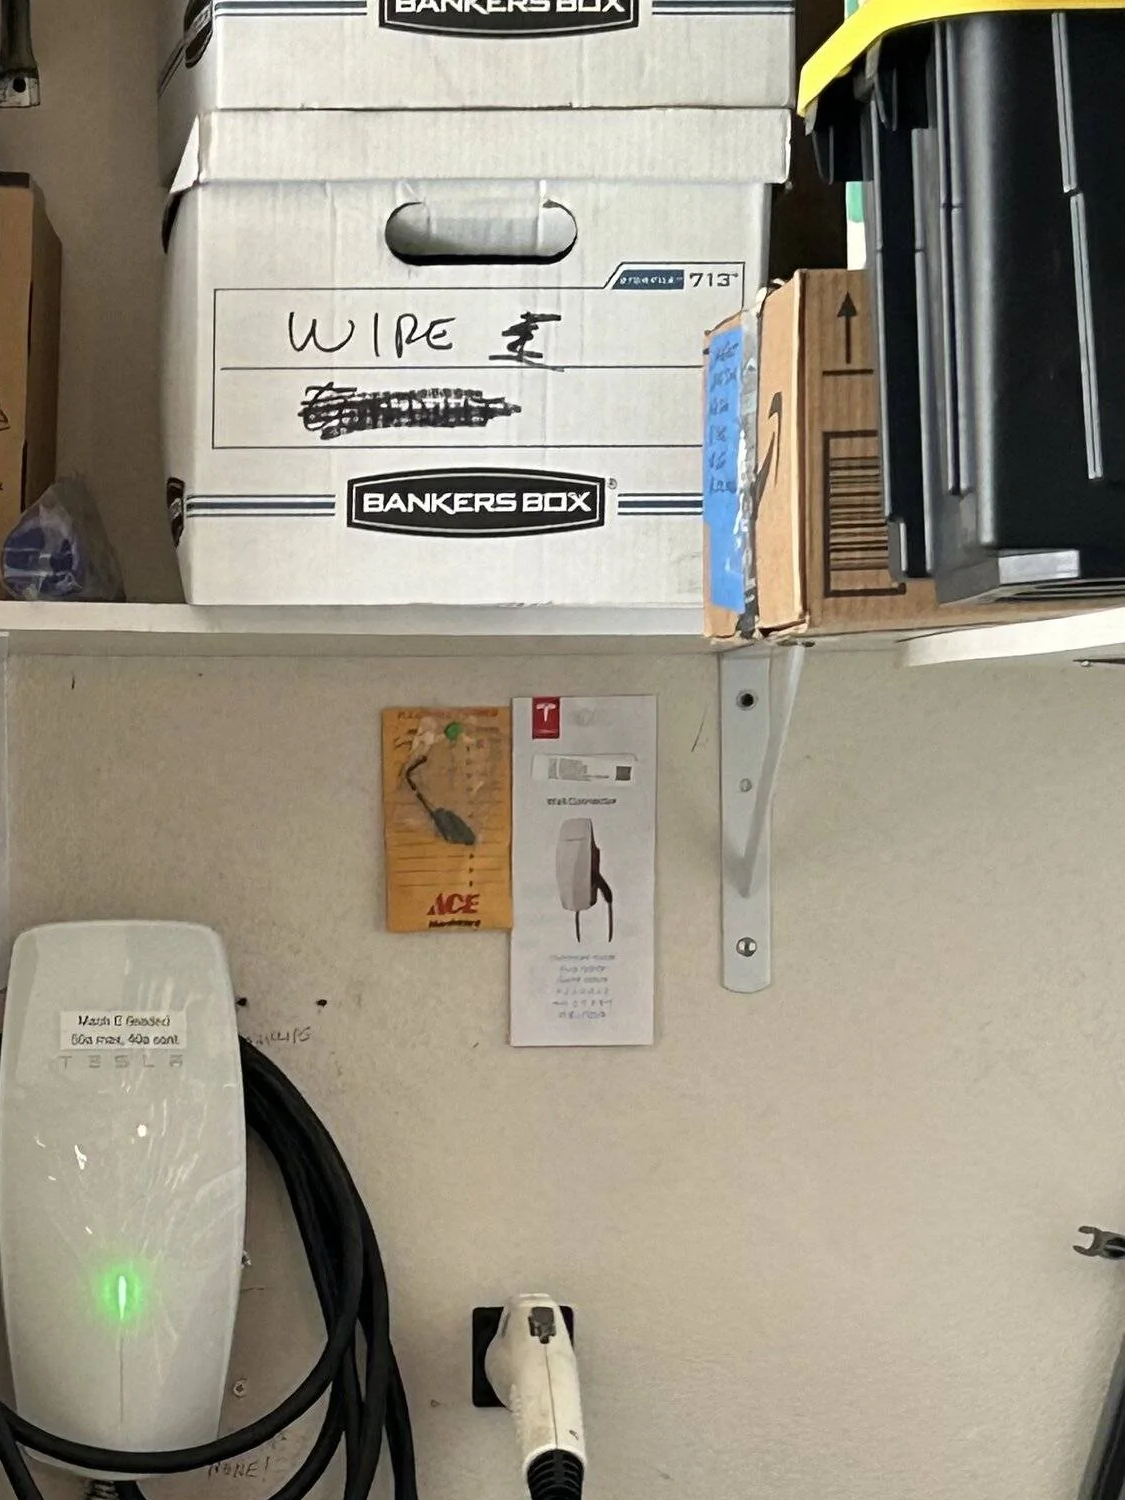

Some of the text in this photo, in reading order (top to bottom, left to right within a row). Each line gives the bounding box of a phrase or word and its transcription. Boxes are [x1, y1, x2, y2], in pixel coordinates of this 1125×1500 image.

[288, 311, 456, 358] WIRE
[362, 491, 592, 514] BANKERS BOX
[427, 893, 481, 915] ACE
